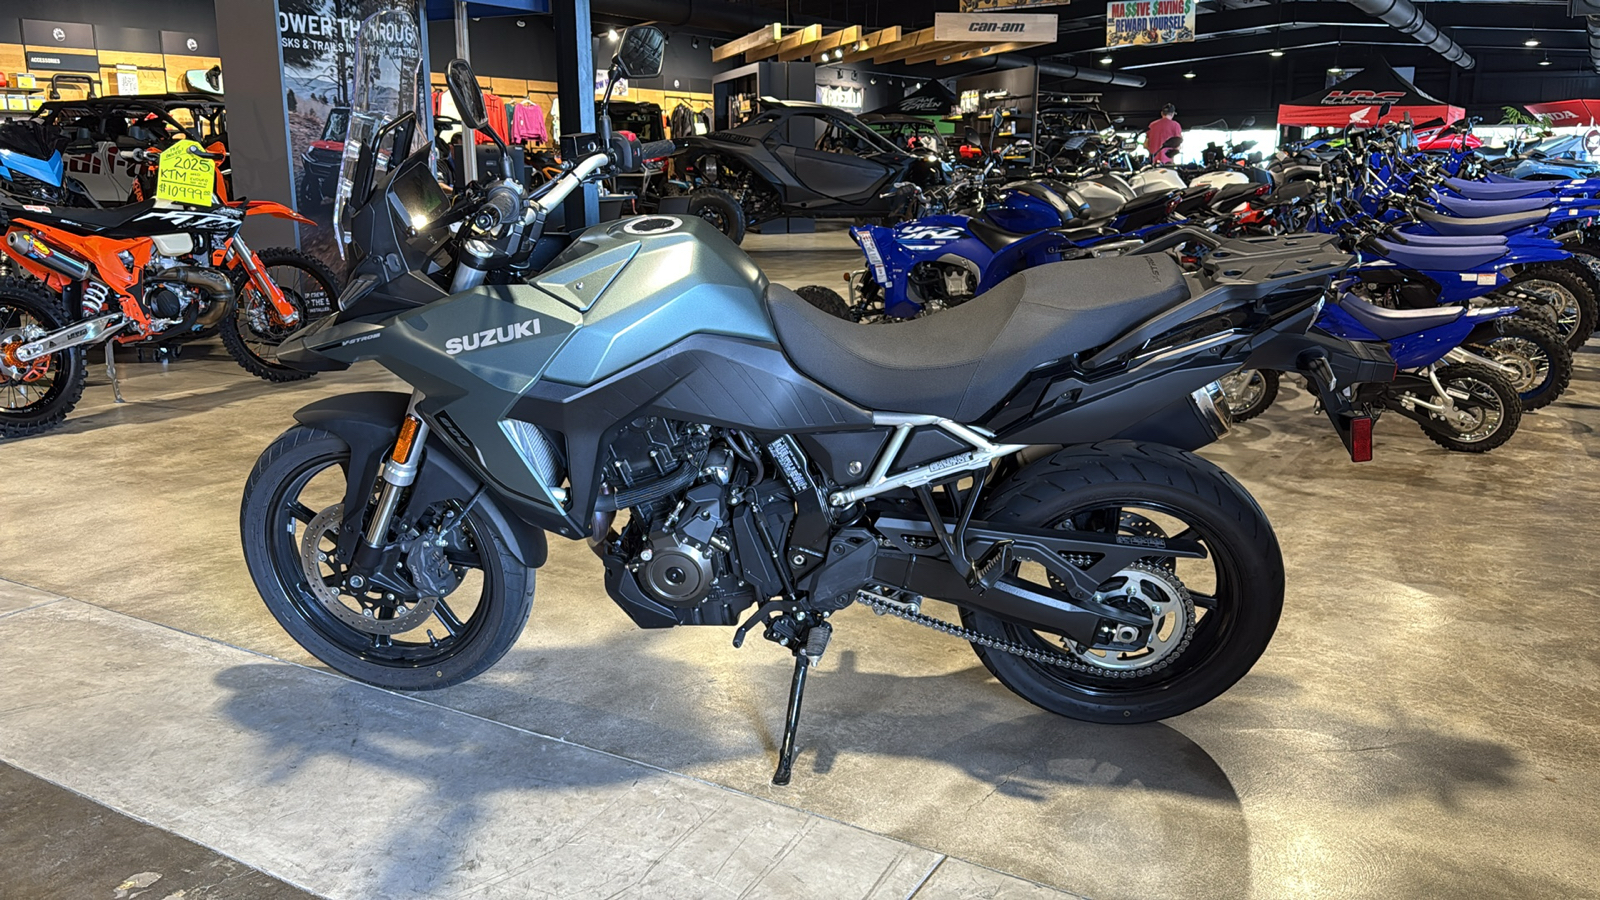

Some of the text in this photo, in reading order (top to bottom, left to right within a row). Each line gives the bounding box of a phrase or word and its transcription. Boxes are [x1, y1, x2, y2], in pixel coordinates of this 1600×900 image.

[279, 11, 333, 37] OWER
[968, 22, 1026, 32] can-am
[1116, 17, 1148, 33] REWARD
[1149, 15, 1186, 31] YOURSELF
[302, 39, 309, 49] &
[313, 40, 344, 53] TRAILS
[174, 156, 211, 172] 2025
[160, 169, 187, 182] KTM
[312, 298, 325, 307] THE
[342, 332, 381, 347] V-STROM
[445, 318, 541, 355] SUZUKI
